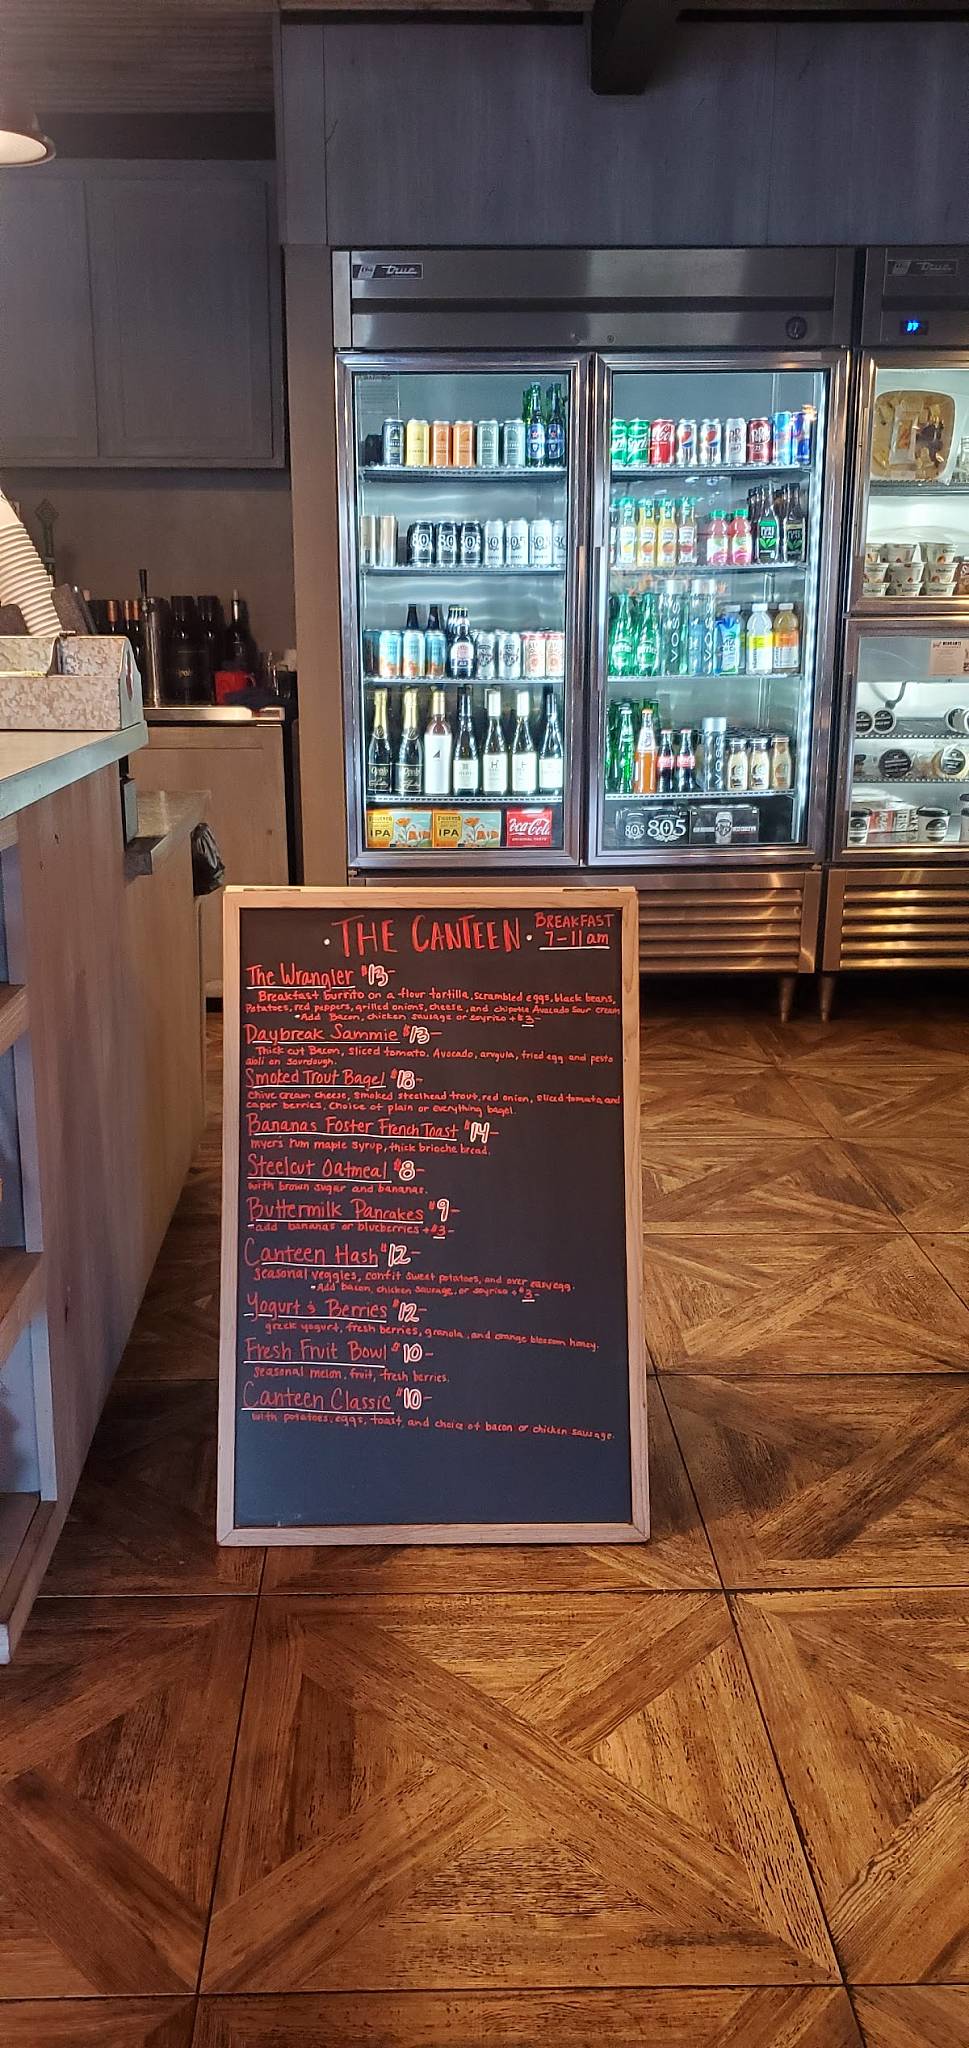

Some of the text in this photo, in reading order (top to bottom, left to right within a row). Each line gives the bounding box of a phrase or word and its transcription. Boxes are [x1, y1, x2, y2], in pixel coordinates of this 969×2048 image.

[381, 265, 418, 275] True
[670, 600, 680, 662] VOSS
[715, 736, 724, 785] VOSS
[370, 829, 391, 837] IPA
[438, 829, 459, 837] IPA
[625, 824, 645, 836] 805
[647, 819, 687, 837] 805
[534, 911, 615, 929] BREAKFAST
[330, 914, 521, 957] THE CANTEEN
[246, 964, 276, 986] The
[280, 963, 354, 990] Wrangler
[258, 990, 319, 1002] Breakfast
[324, 990, 365, 1001] burrito
[398, 988, 426, 999] flour
[474, 991, 522, 1001] scrambled
[555, 992, 582, 1002] black
[294, 1002, 310, 1011] red
[355, 1003, 388, 1013] grilled
[470, 1005, 489, 1013] and
[494, 1005, 529, 1014] chipotle
[532, 1006, 569, 1014] Avocado
[595, 1007, 620, 1015] cream
[367, 1012, 407, 1020] chicken
[412, 1014, 455, 1022] sausage
[469, 1015, 506, 1023] soyrizo
[243, 1023, 325, 1044] Daybreak
[330, 1023, 399, 1041] Sammie
[256, 1047, 284, 1056] Thick
[287, 1048, 305, 1056] cut
[348, 1046, 380, 1055] sliced
[521, 1050, 544, 1060] fried
[546, 1054, 564, 1064] egg
[569, 1053, 586, 1062] and
[590, 1055, 613, 1066] pesto
[245, 1068, 299, 1088] Smoked
[303, 1070, 340, 1085] Trout
[342, 1069, 385, 1091] Bagel
[247, 1091, 277, 1100] Chive
[279, 1092, 311, 1100] cream
[353, 1092, 393, 1101] smoked
[398, 1091, 447, 1101] steelhead
[482, 1093, 498, 1101] red
[536, 1093, 564, 1102] sliced
[604, 1095, 620, 1104] and
[246, 1102, 277, 1110] caper
[328, 1101, 367, 1110] Choice
[388, 1103, 413, 1114] plain
[433, 1104, 483, 1118] everything
[246, 1112, 317, 1136] Bananas
[325, 1116, 374, 1134] Foster
[378, 1118, 419, 1137] French
[422, 1122, 459, 1138] Toast
[288, 1139, 310, 1149] rum
[314, 1141, 347, 1151] maple
[389, 1142, 416, 1152] thick
[419, 1143, 458, 1154] brioche
[247, 1153, 315, 1177] Steelcut
[322, 1158, 388, 1179] Oatmeal
[247, 1182, 274, 1190] with
[279, 1181, 309, 1191] brown
[314, 1184, 346, 1195] sugar
[351, 1185, 373, 1193] and
[246, 1196, 343, 1221] Buttermilk
[350, 1198, 424, 1220] Pancakes
[287, 1222, 419, 1234] bananas blueberries
[244, 1237, 325, 1266] Canteen
[335, 1244, 379, 1264] Hash
[253, 1268, 307, 1281] seasonal
[365, 1271, 402, 1281] confit
[406, 1273, 435, 1282] sweet
[484, 1275, 502, 1284] and
[530, 1280, 552, 1290] easy
[376, 1285, 412, 1294] chicken
[472, 1288, 508, 1297] soyrizo
[247, 1292, 300, 1321] Yogurt
[325, 1299, 388, 1317] Berries
[265, 1322, 297, 1335] greek
[345, 1322, 376, 1332] fresh
[471, 1331, 491, 1339] and
[494, 1333, 527, 1344] orange
[530, 1335, 566, 1346] blossom
[244, 1337, 292, 1360] Fresh
[300, 1338, 338, 1361] Fruit
[347, 1340, 387, 1361] Bowl
[254, 1367, 408, 1381] seasonal fresh
[243, 1380, 324, 1408] Canteen
[331, 1387, 391, 1410] Classic
[251, 1412, 278, 1421] with
[408, 1417, 430, 1427] and
[434, 1419, 463, 1430] choice
[485, 1421, 512, 1432] bacon
[533, 1424, 567, 1435] chicken
